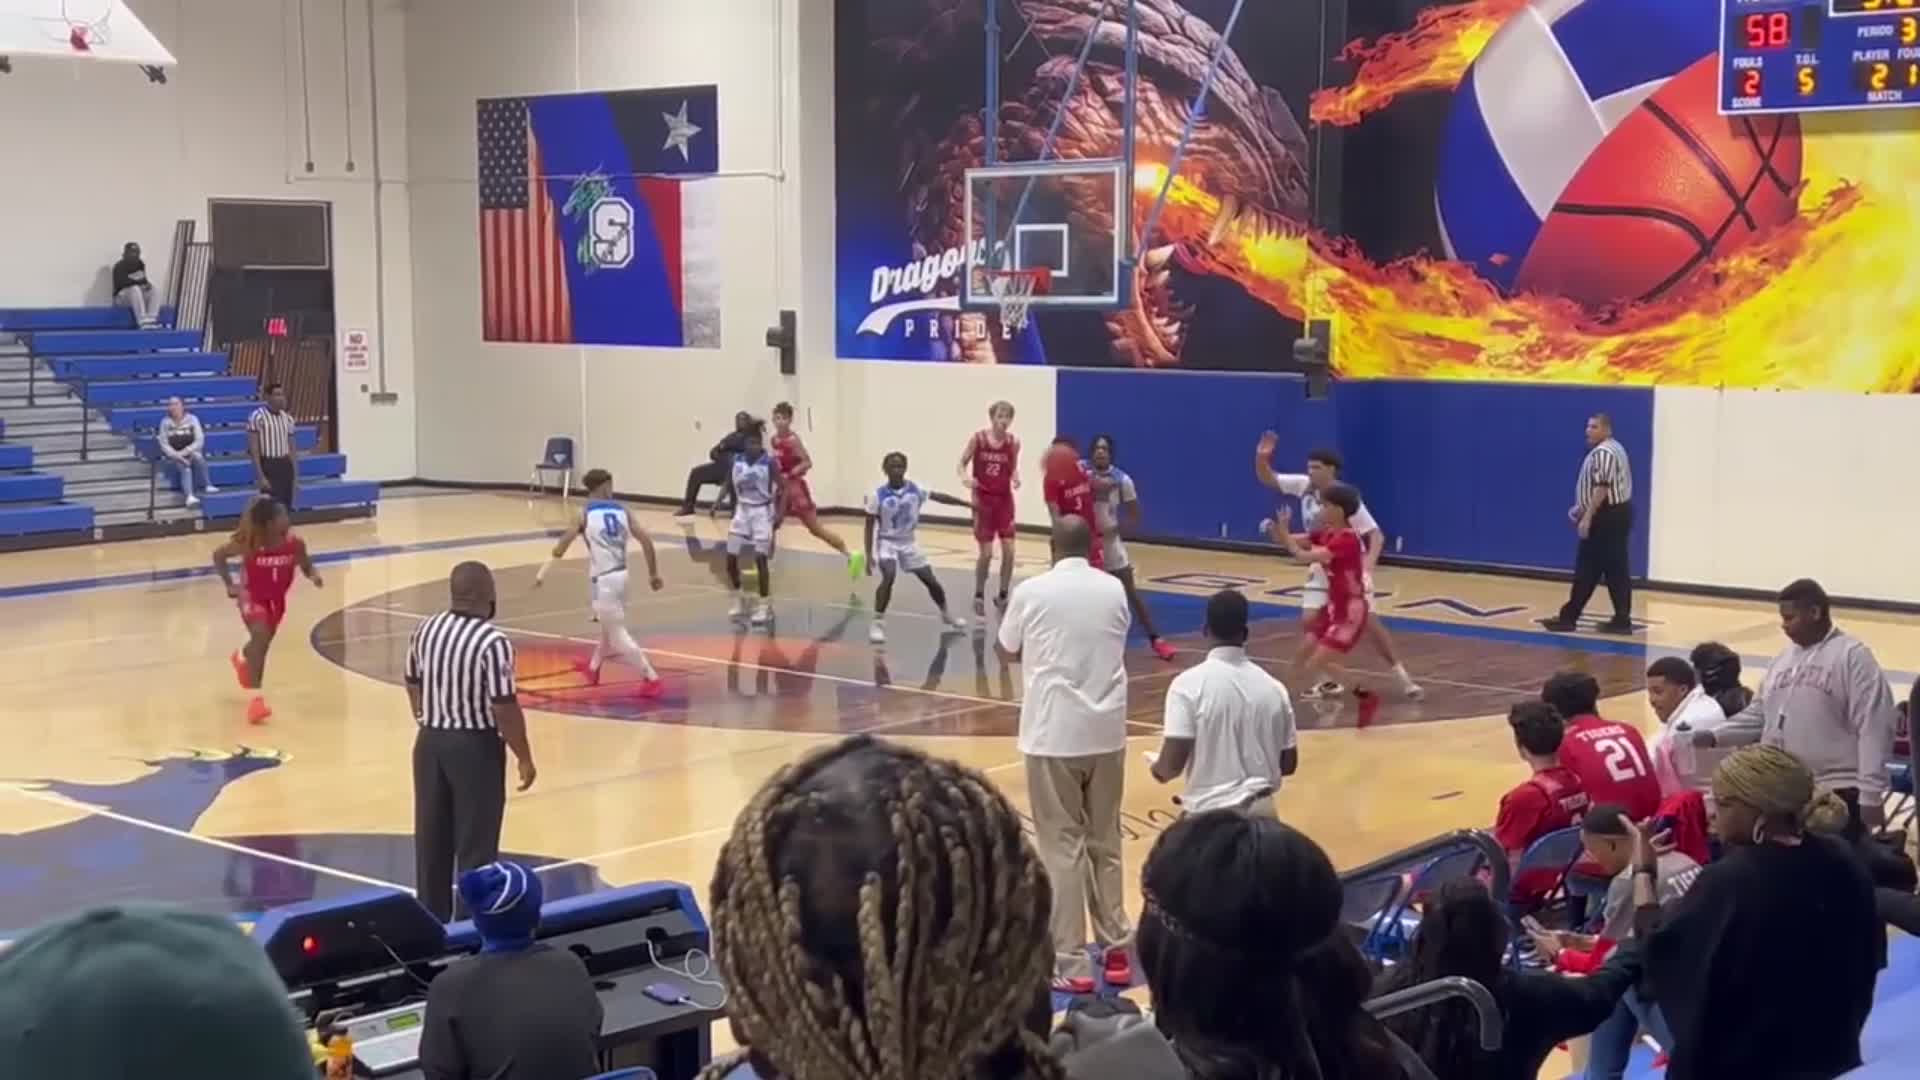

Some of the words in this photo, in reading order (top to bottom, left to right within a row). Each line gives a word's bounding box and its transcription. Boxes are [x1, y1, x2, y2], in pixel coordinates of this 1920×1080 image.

[1746, 13, 1788, 47] 58
[1857, 25, 1894, 38] PERIOD
[1901, 15, 1917, 44] 3
[1852, 48, 1890, 62] PLAYER
[1744, 70, 1761, 95] 2
[1797, 66, 1815, 96] 5
[1870, 62, 1889, 89] 2
[1867, 90, 1902, 102] MATCH
[905, 317, 1012, 340] PRIDE
[1575, 725, 1626, 743] TIGERS
[1594, 737, 1647, 783] 21
